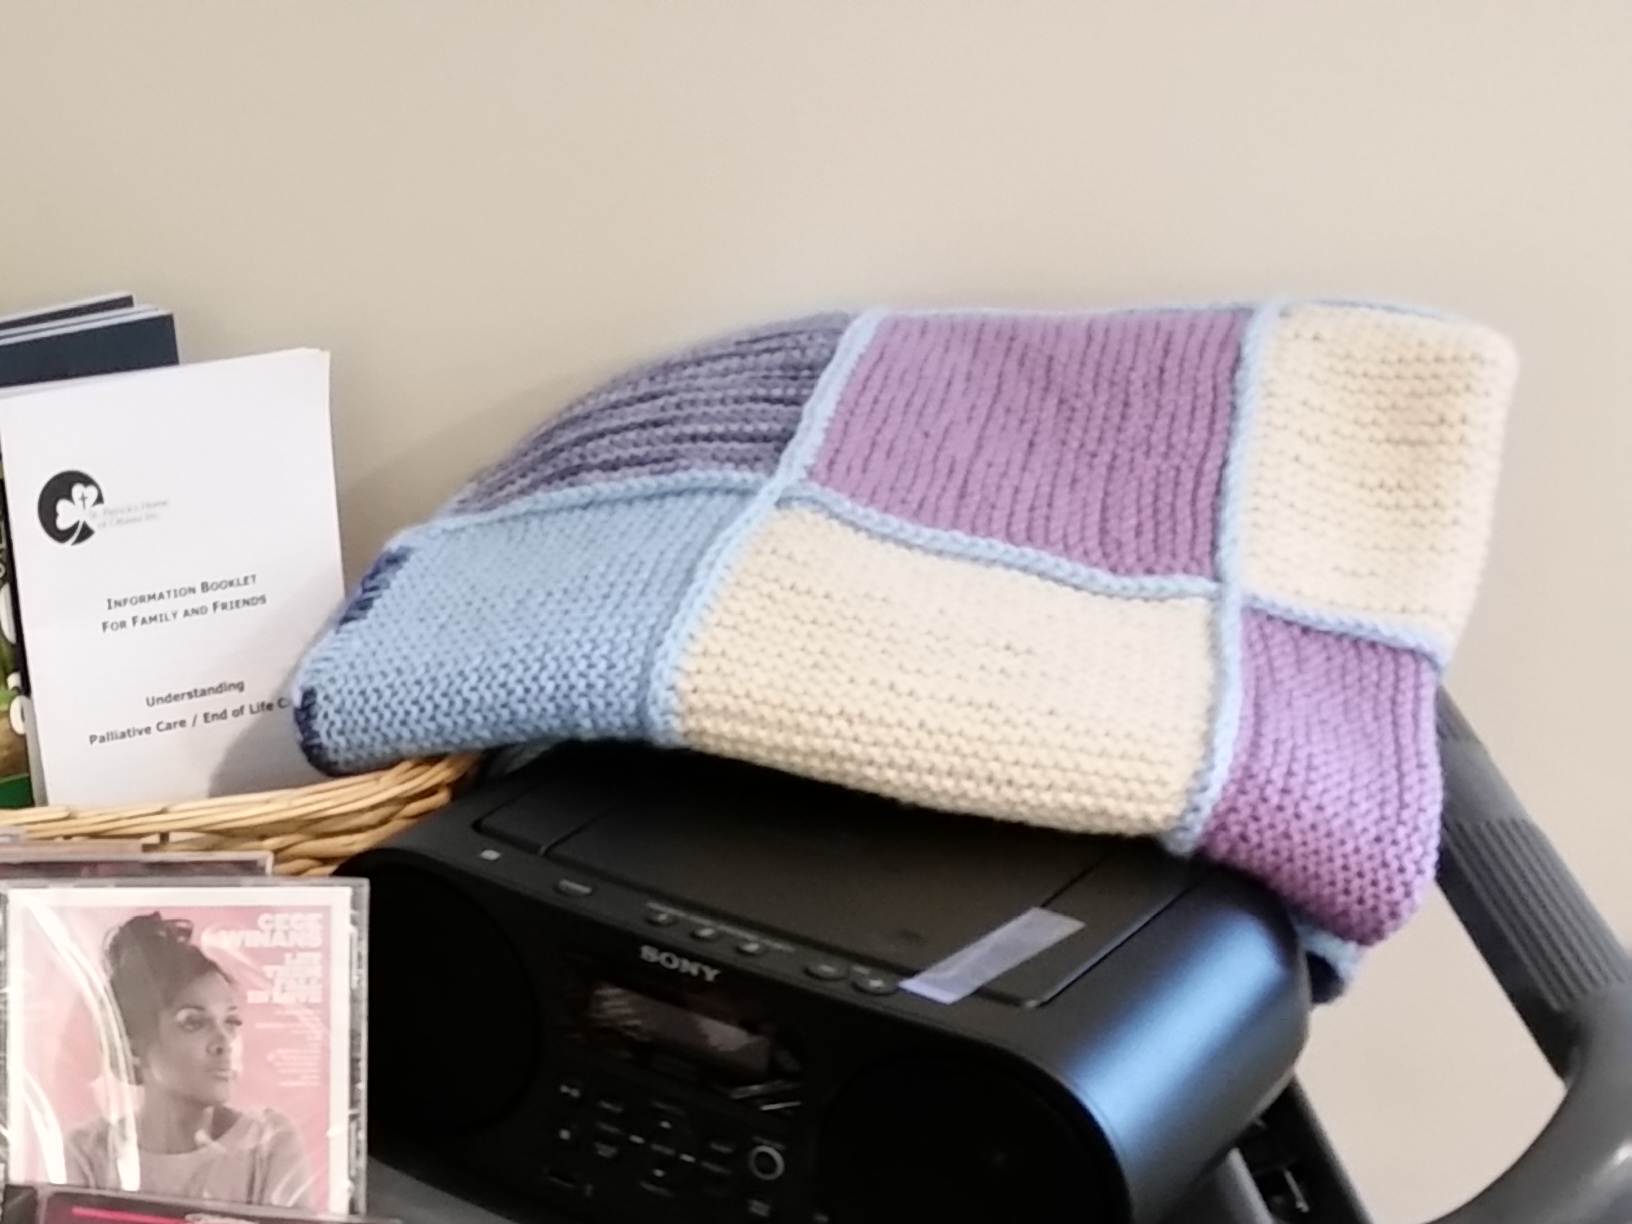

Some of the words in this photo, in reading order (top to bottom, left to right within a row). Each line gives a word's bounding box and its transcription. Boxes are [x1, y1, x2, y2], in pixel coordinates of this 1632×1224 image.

[106, 585, 196, 611] INFORMATION
[200, 574, 257, 594] BOOKLET
[101, 618, 127, 633] FOR
[131, 608, 178, 628] FAMILY
[183, 604, 208, 620] AND
[212, 594, 267, 614] FRIENDS
[145, 681, 245, 707] Understanding
[89, 726, 152, 746] Palliative
[155, 717, 187, 734] Care
[203, 709, 228, 724] End
[231, 705, 246, 719] of
[249, 700, 274, 715] Life
[277, 697, 290, 709] C
[640, 945, 720, 982] SONY
